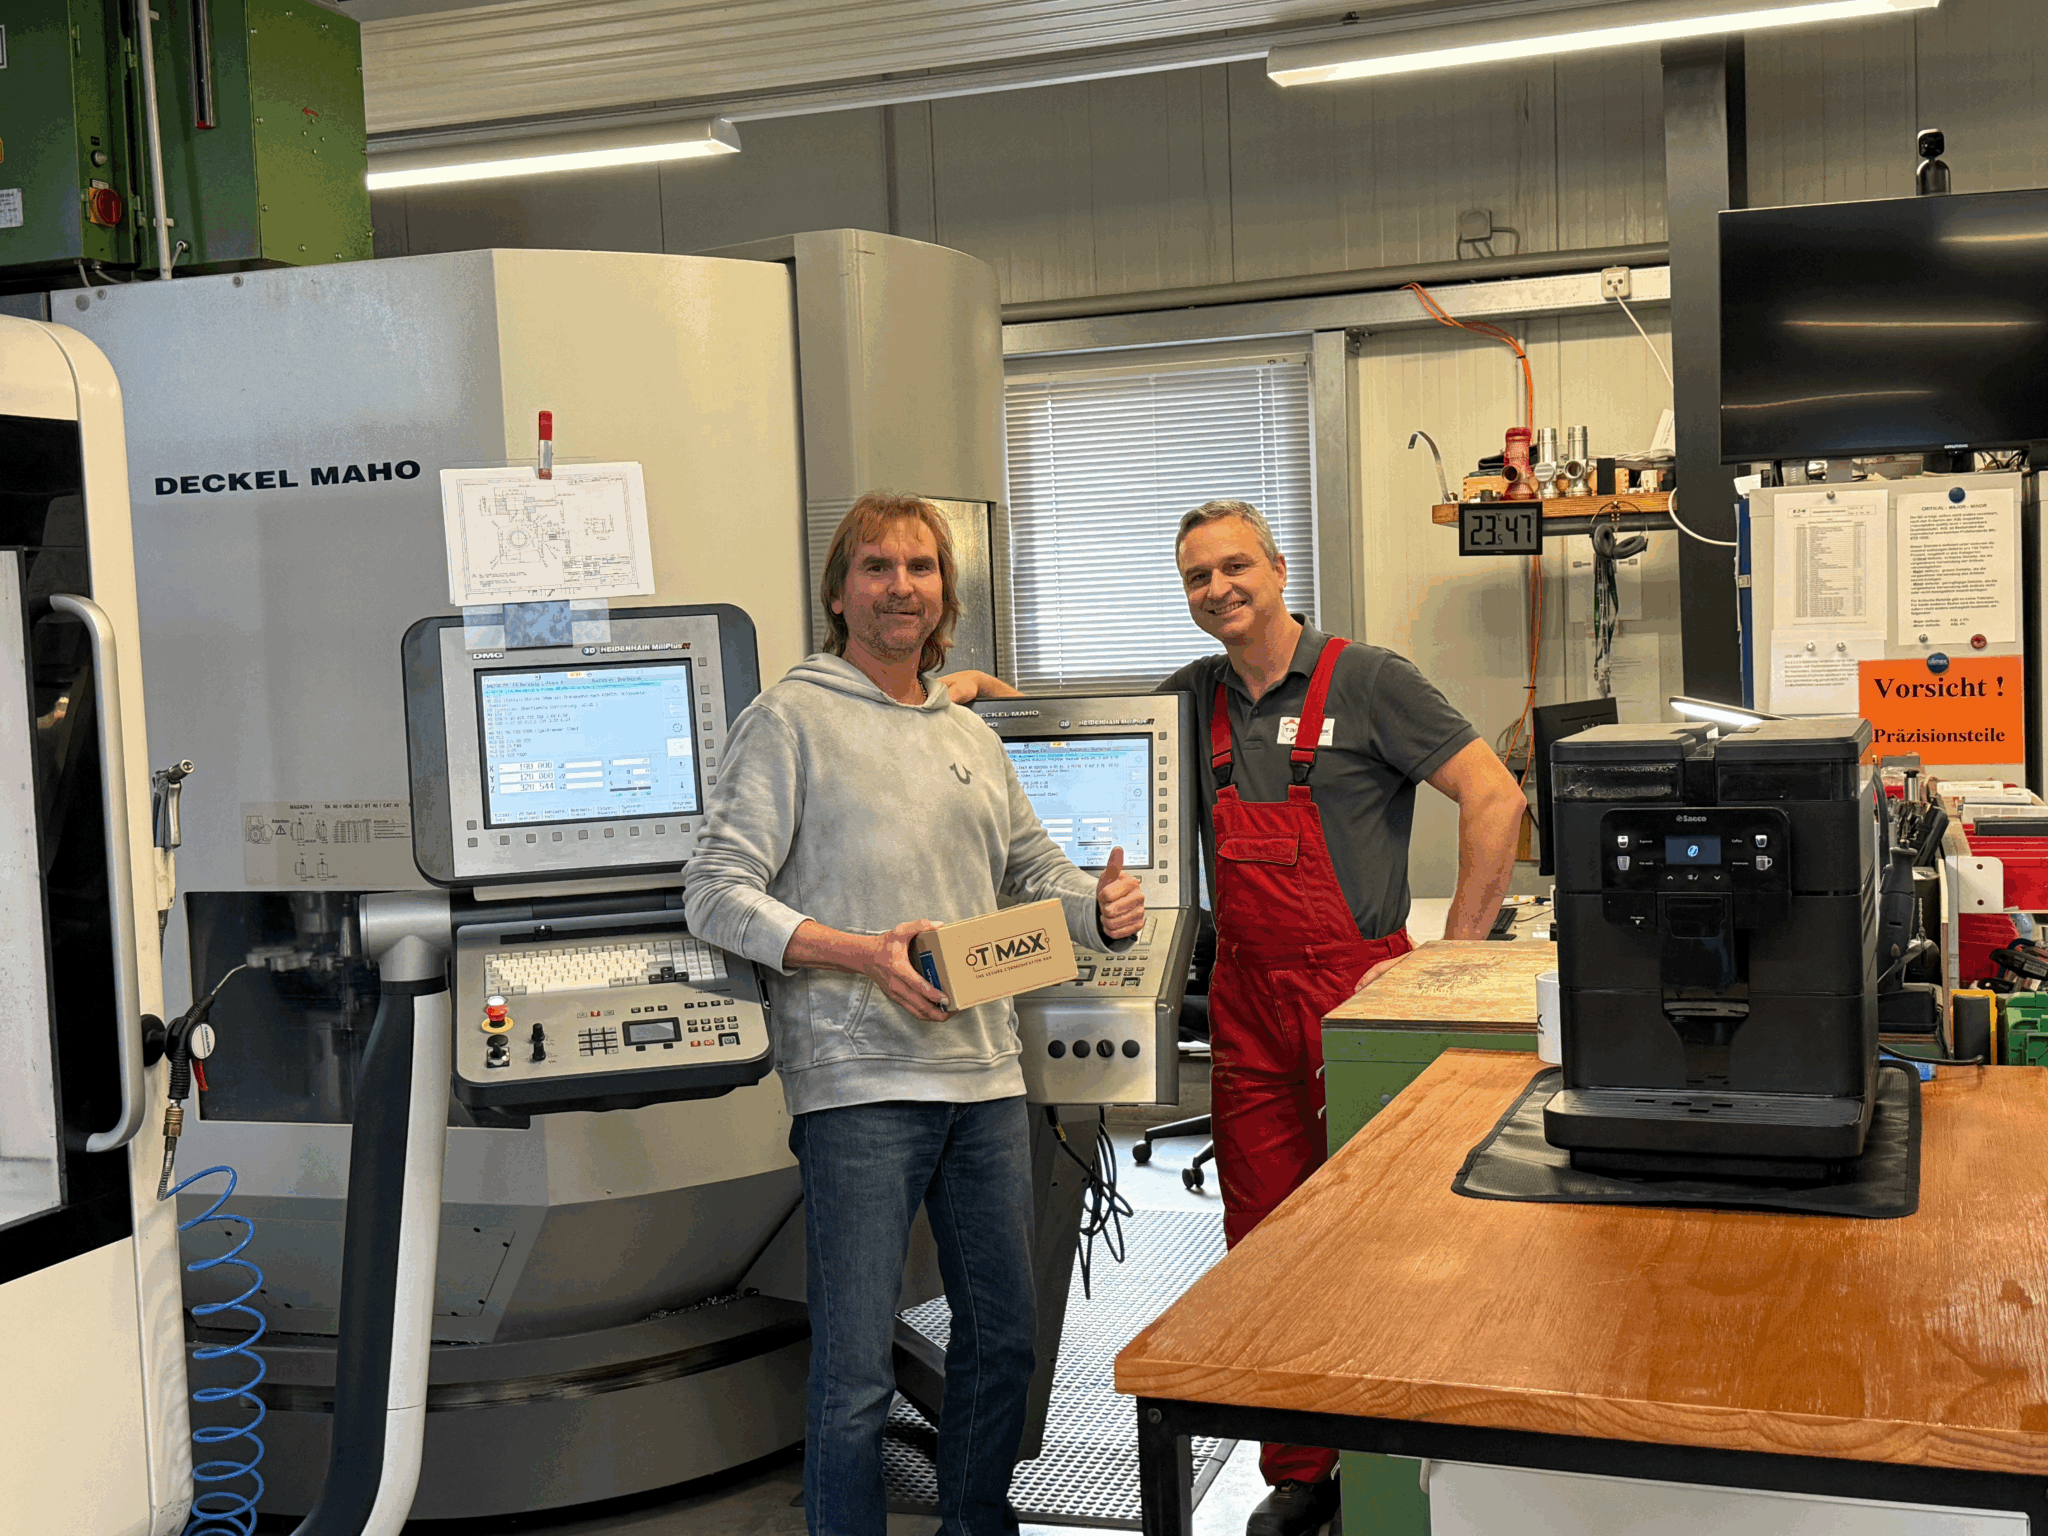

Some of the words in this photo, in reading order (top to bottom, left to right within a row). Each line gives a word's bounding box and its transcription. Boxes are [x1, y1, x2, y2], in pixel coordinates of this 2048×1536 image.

[155, 470, 298, 495] DECKEL
[310, 460, 420, 486] MAHO
[473, 652, 504, 660] DMG
[600, 644, 650, 654] HEIDENHAIN
[1874, 678, 1987, 698] Vorsicht
[1996, 676, 2004, 697] !
[1874, 728, 2006, 743] Präzisionsteile
